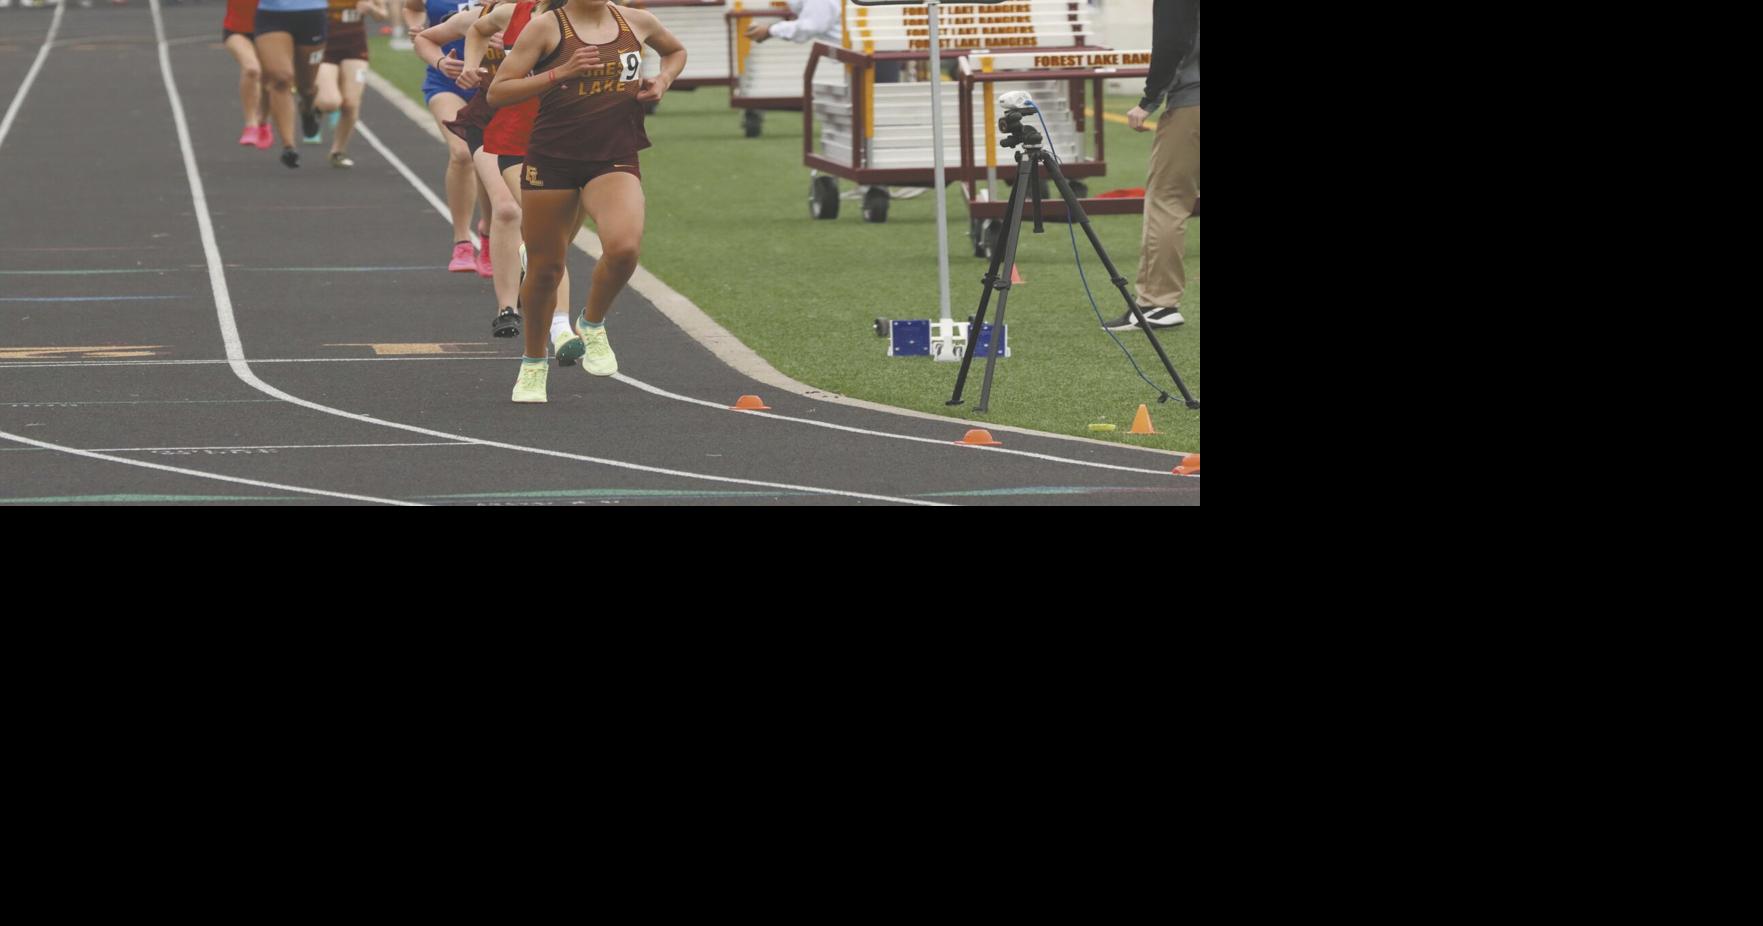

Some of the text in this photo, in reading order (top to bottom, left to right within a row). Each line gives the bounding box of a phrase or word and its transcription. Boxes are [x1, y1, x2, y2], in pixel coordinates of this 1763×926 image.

[903, 6, 944, 15] FORET
[978, 4, 1031, 13] RANGERS
[954, 38, 980, 47] LAKE
[985, 37, 1037, 47] RANGERS
[626, 53, 639, 80] 9
[1034, 52, 1152, 67] FOREST LAKE RAN
[578, 80, 626, 96] LAKE
